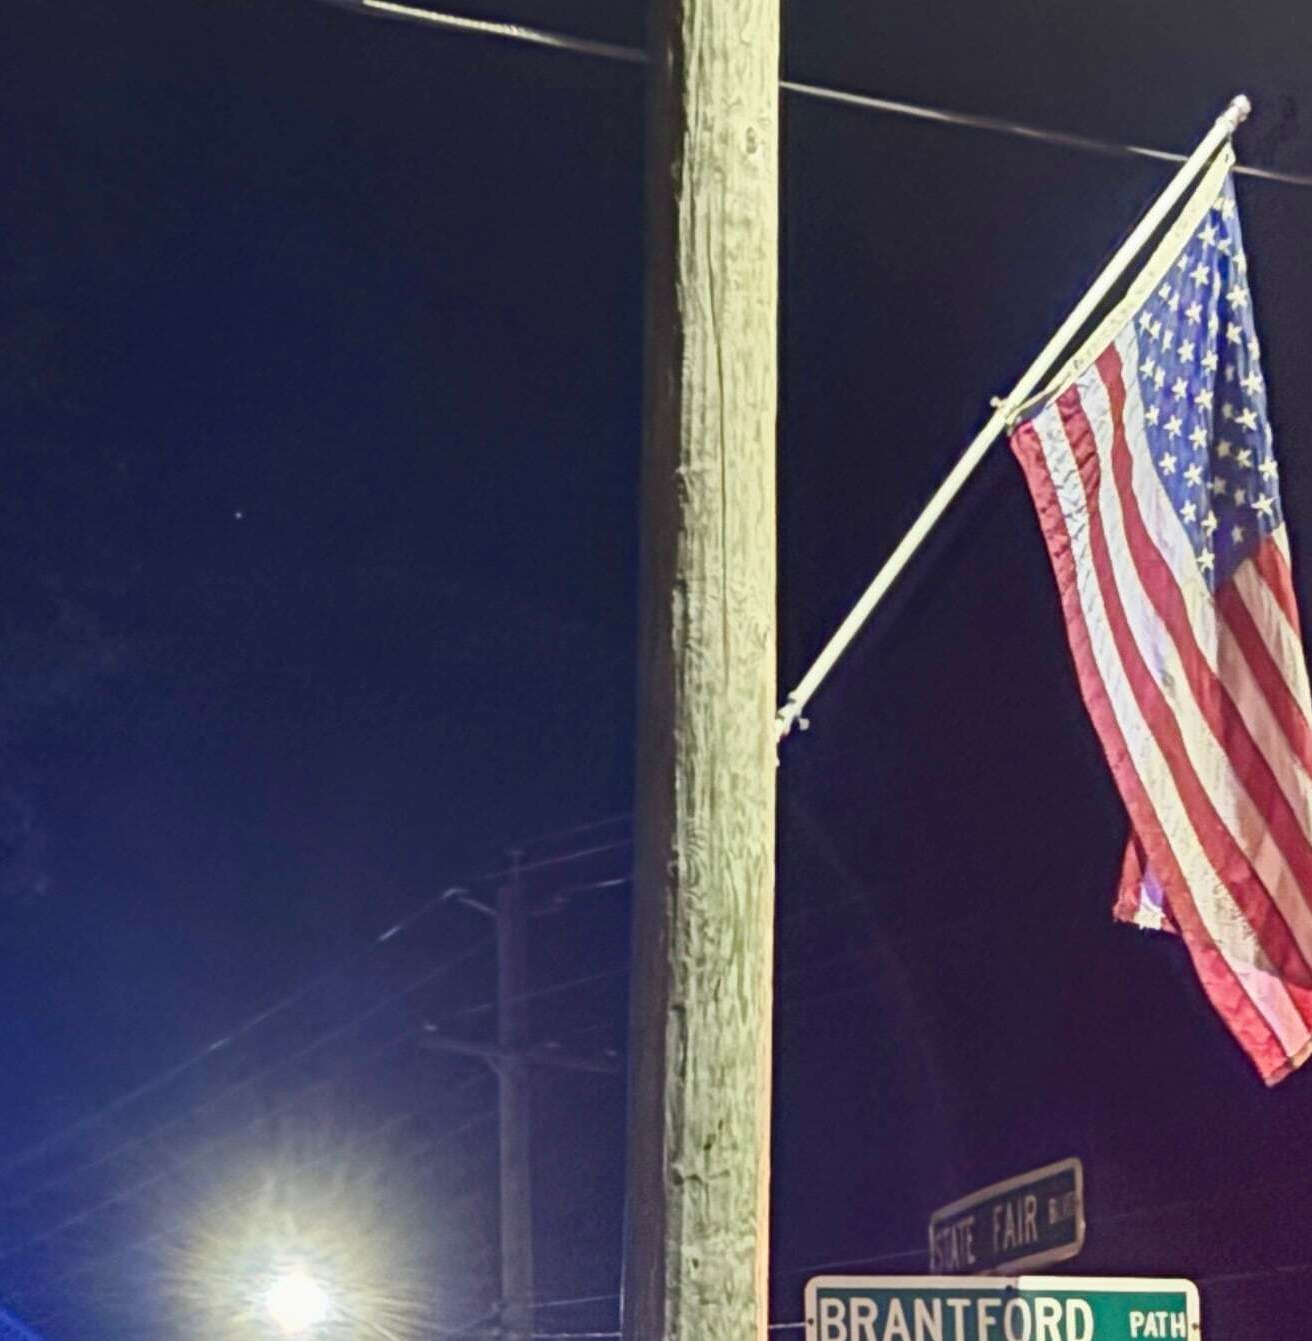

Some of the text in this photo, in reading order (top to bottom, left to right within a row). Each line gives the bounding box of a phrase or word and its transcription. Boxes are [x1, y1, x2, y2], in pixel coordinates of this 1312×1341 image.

[936, 1216, 976, 1274] STATE
[992, 1194, 1038, 1254] FAIR
[1128, 1310, 1186, 1339] PATH
